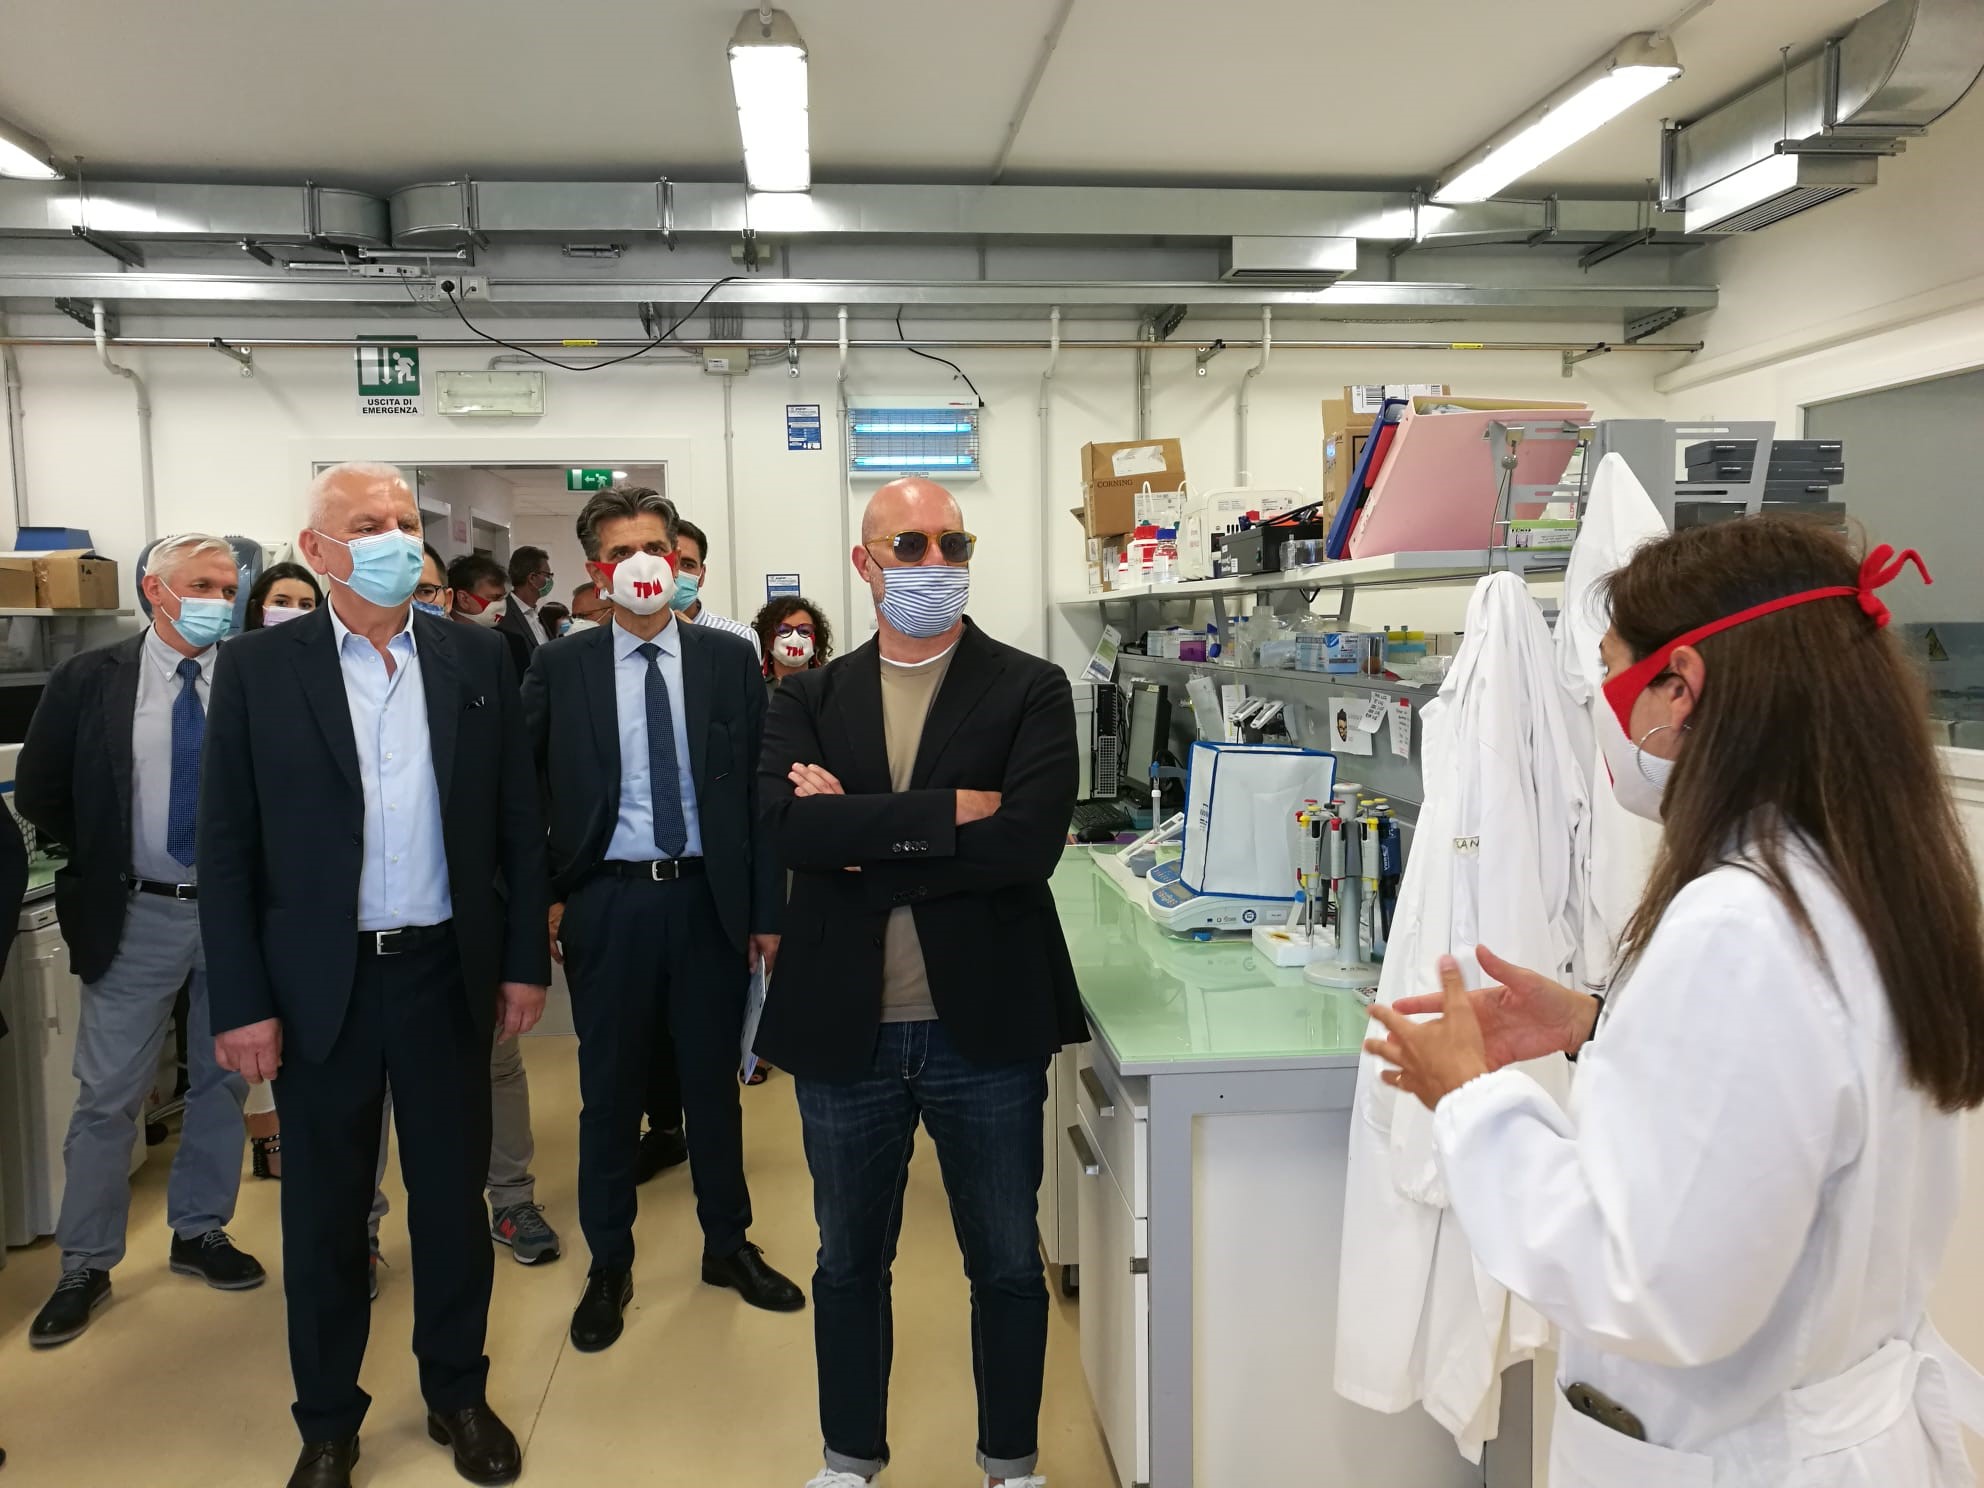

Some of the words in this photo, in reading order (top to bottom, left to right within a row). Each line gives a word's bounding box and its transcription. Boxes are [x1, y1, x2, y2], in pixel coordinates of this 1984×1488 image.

[367, 398, 401, 406] USCITA
[403, 398, 412, 406] DI
[362, 406, 418, 414] EMERGENZA
[1097, 479, 1133, 489] CORNING
[633, 577, 663, 599] TPM
